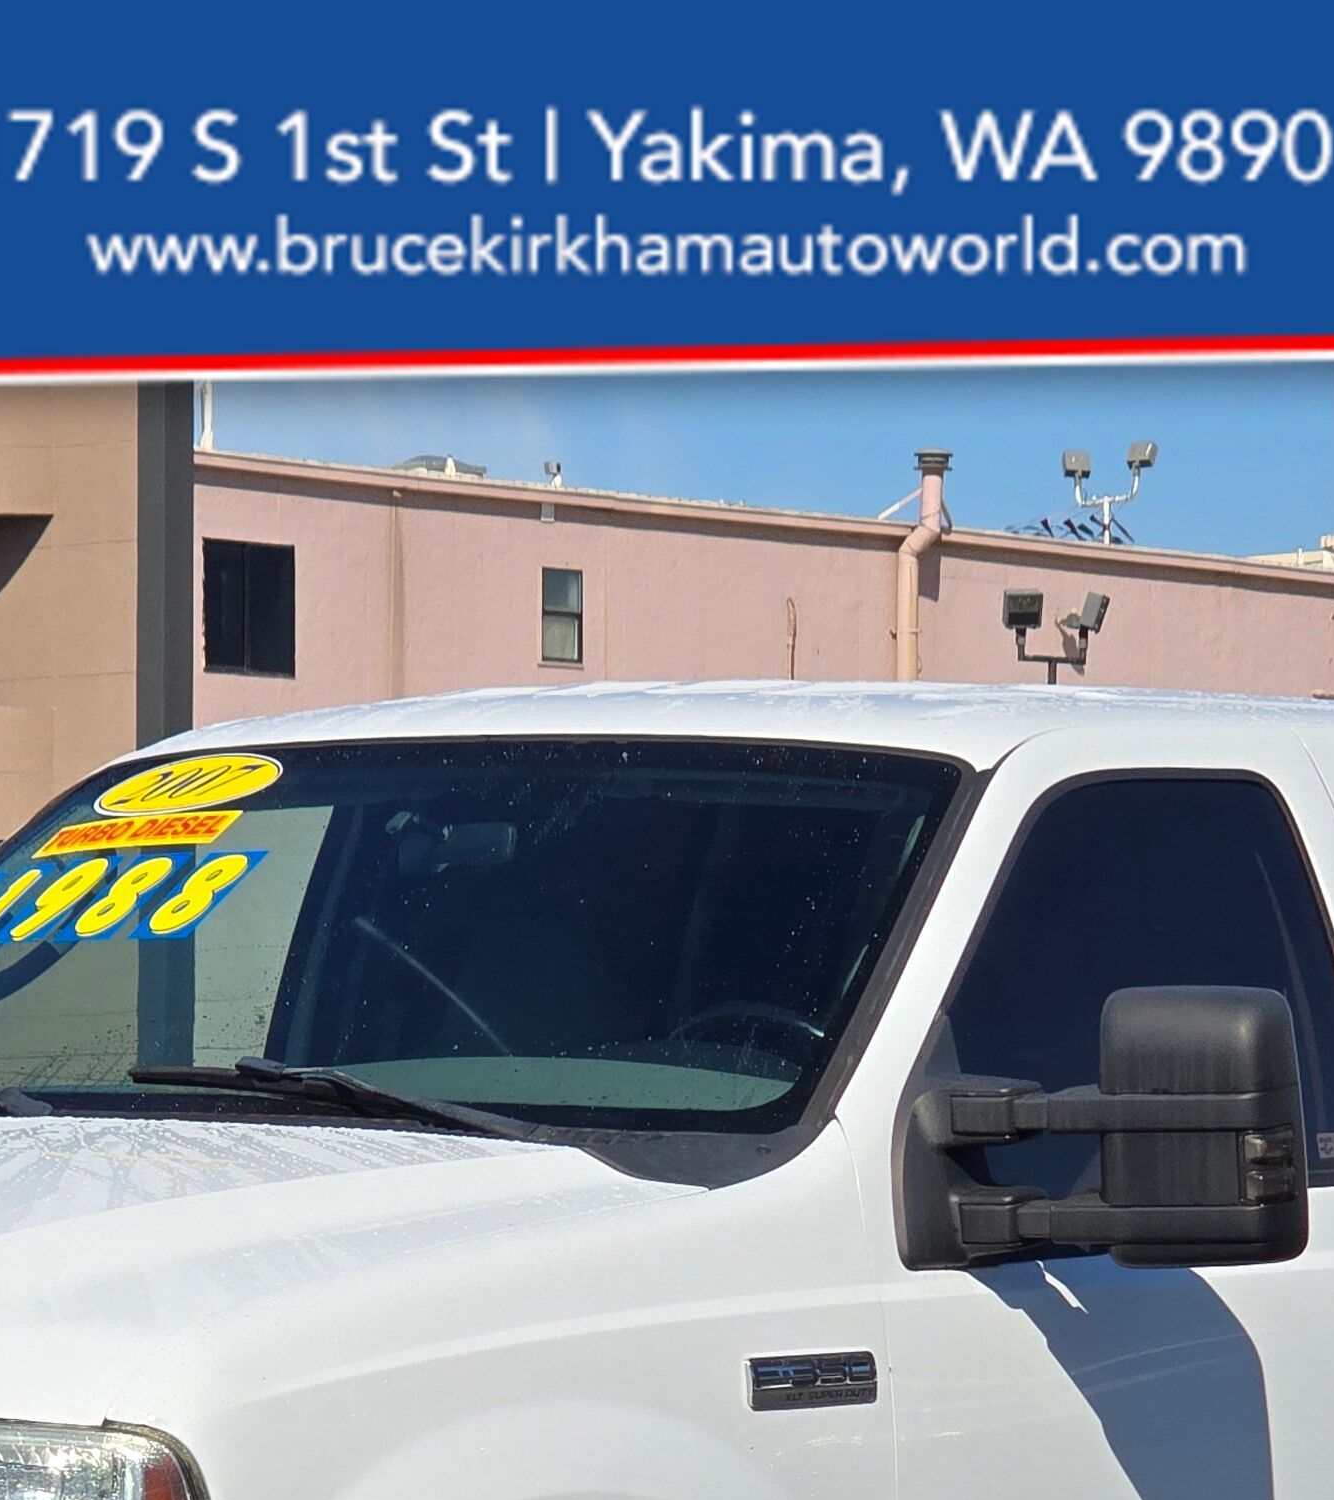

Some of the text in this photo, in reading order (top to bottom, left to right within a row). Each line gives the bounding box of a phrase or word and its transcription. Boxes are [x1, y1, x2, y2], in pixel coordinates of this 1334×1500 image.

[108, 764, 269, 807] 2007
[46, 814, 230, 849] TURBO DIESEL
